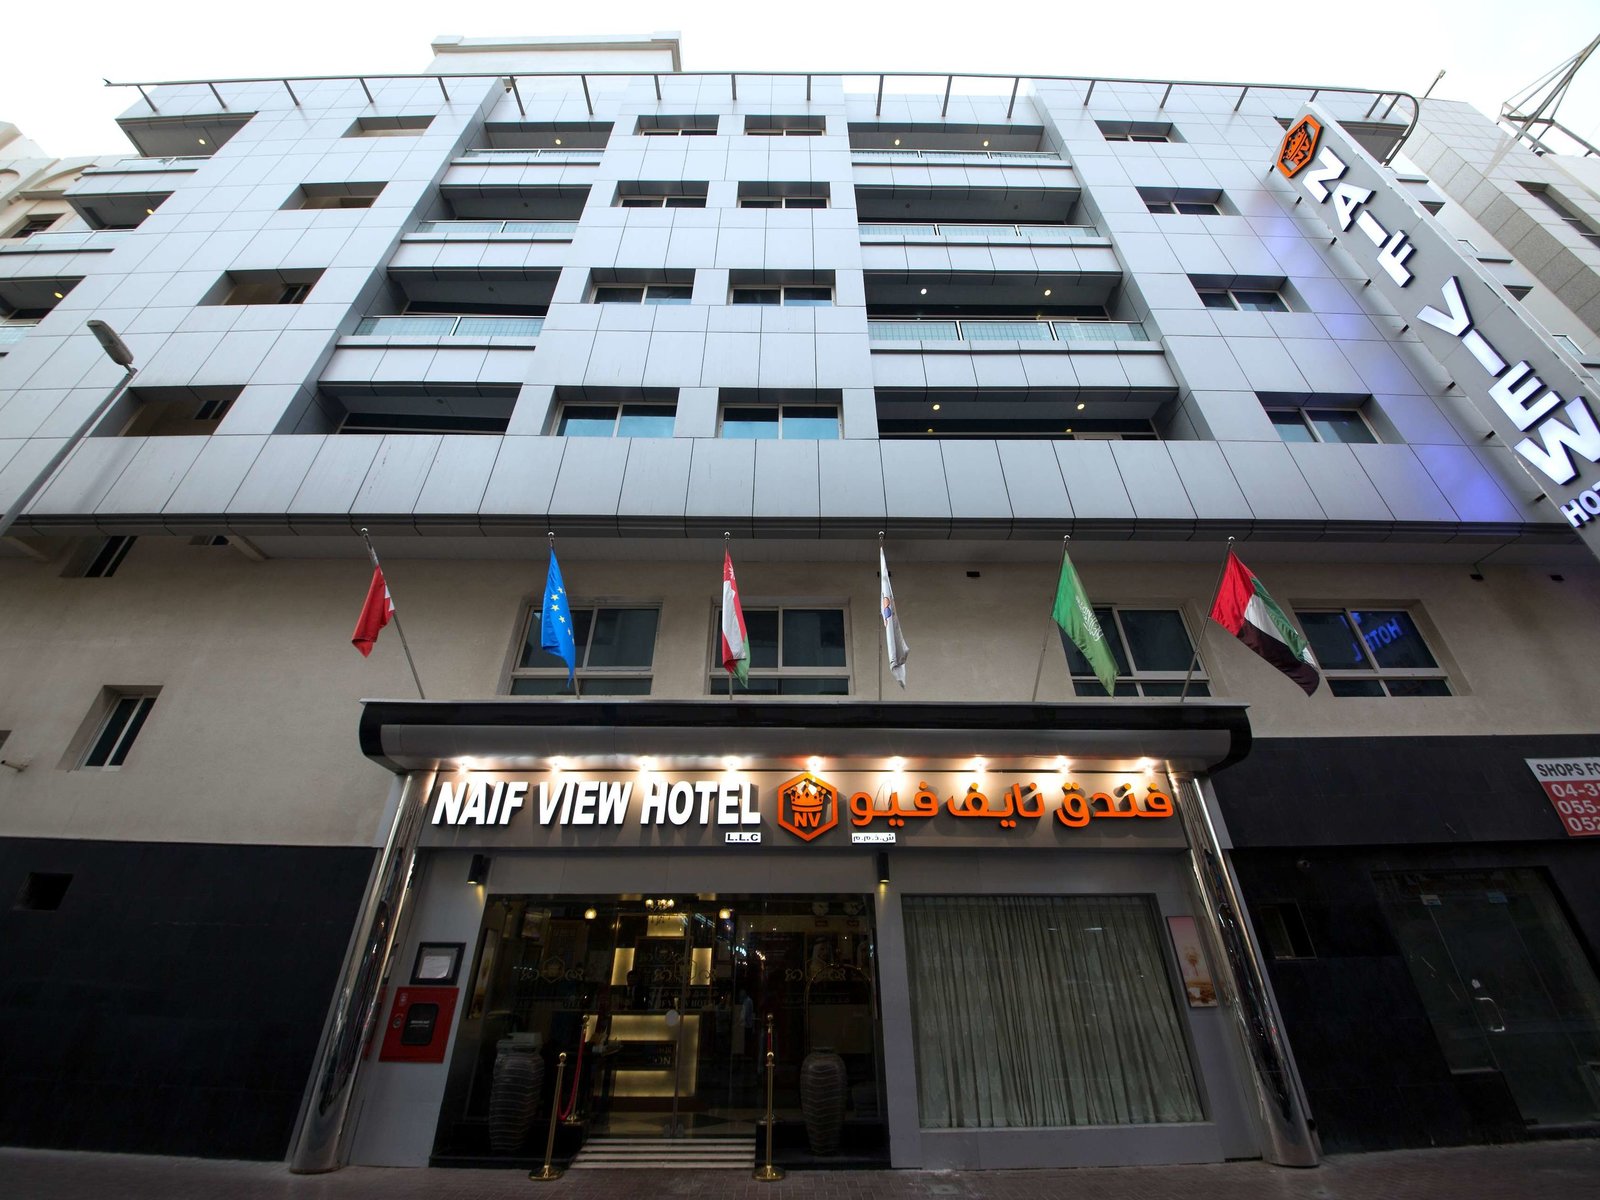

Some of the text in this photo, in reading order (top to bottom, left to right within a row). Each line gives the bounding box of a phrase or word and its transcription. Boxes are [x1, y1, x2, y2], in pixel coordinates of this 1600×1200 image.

[1291, 137, 1311, 166] NV
[1302, 146, 1600, 486] NAIF VIEW
[1536, 763, 1585, 777] SHOPS
[431, 781, 761, 825] NAIF VIEW HOTEL
[850, 781, 1174, 828] فندق نايف فيو
[794, 812, 822, 828] NV
[726, 833, 759, 842] L.L.C
